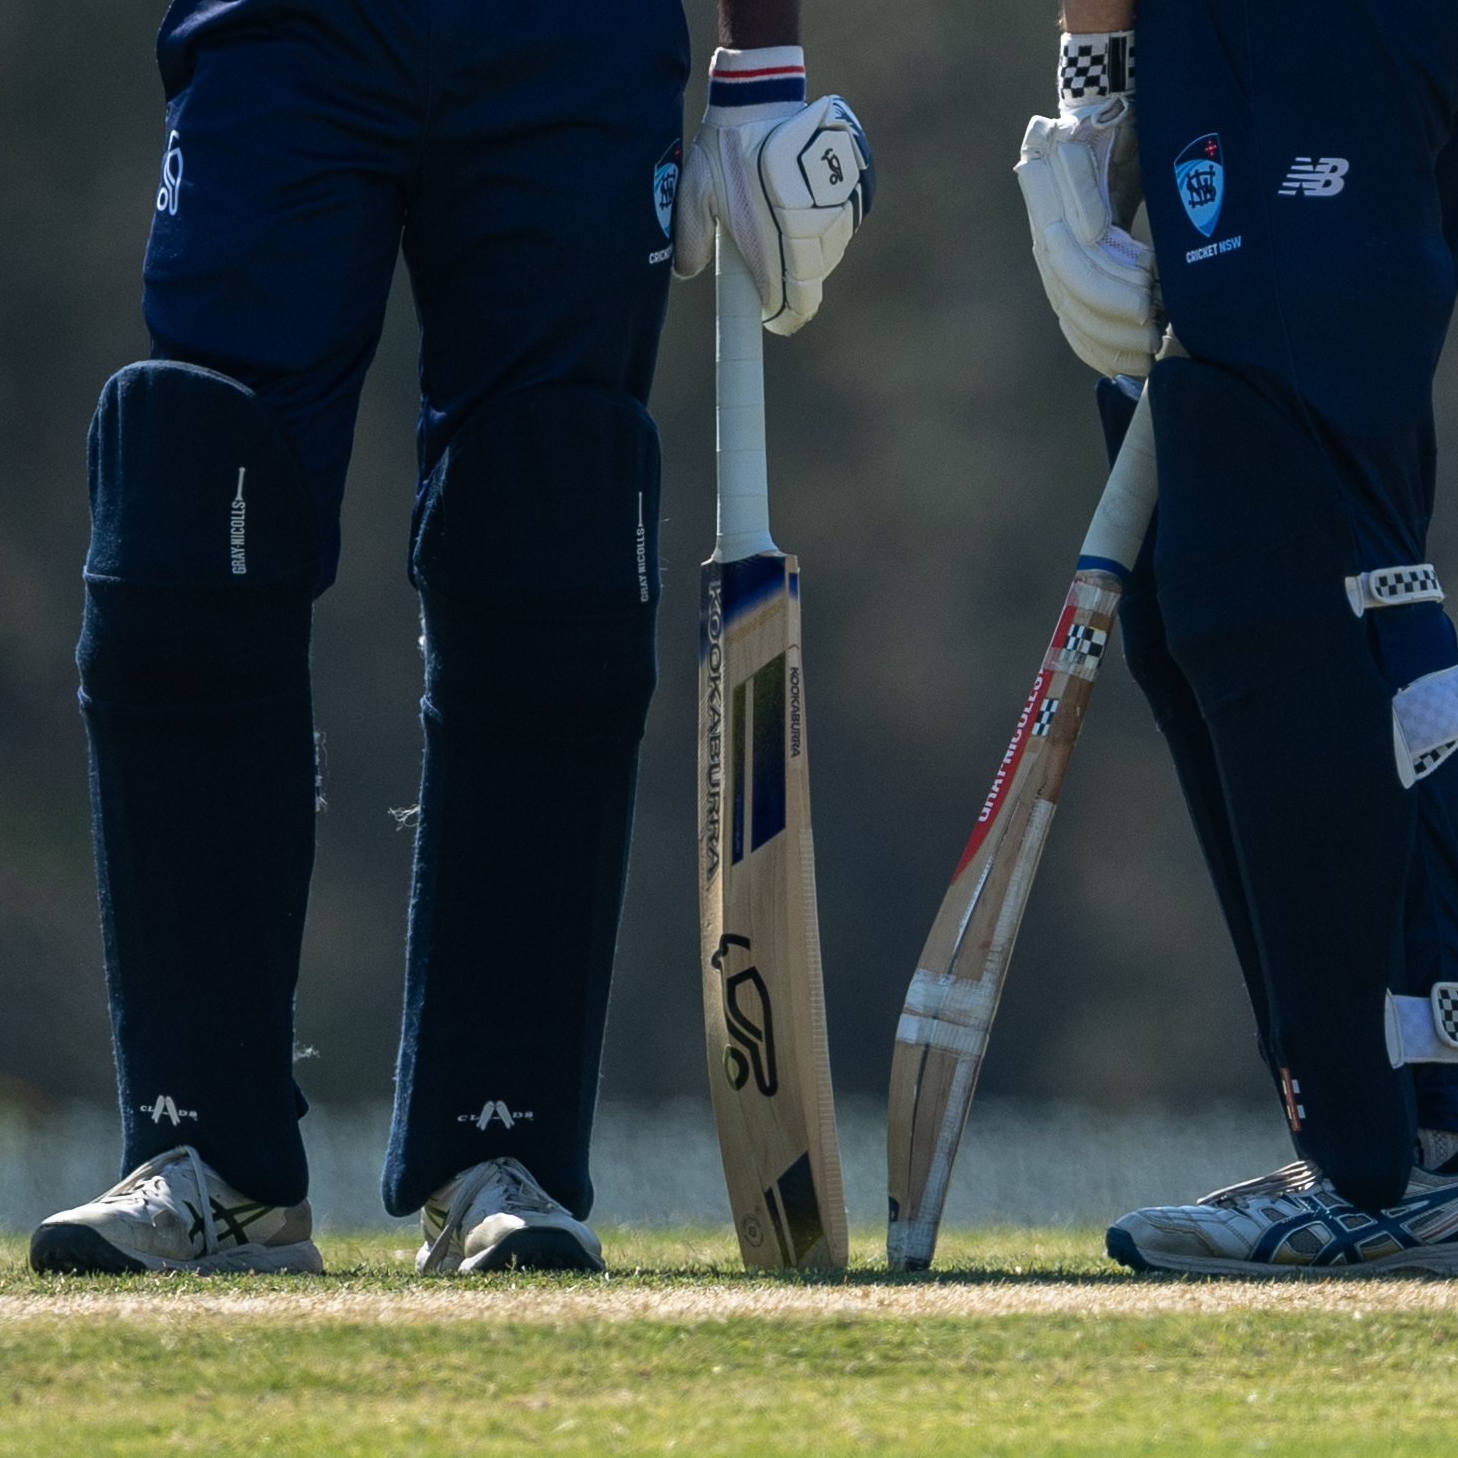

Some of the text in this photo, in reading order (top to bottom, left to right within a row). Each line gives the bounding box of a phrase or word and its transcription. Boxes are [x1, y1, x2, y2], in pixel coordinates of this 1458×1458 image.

[1185, 235, 1243, 264] CRICKET NSW
[707, 579, 724, 880] KOOKABURRA
[789, 666, 802, 759] KOOKABURRA
